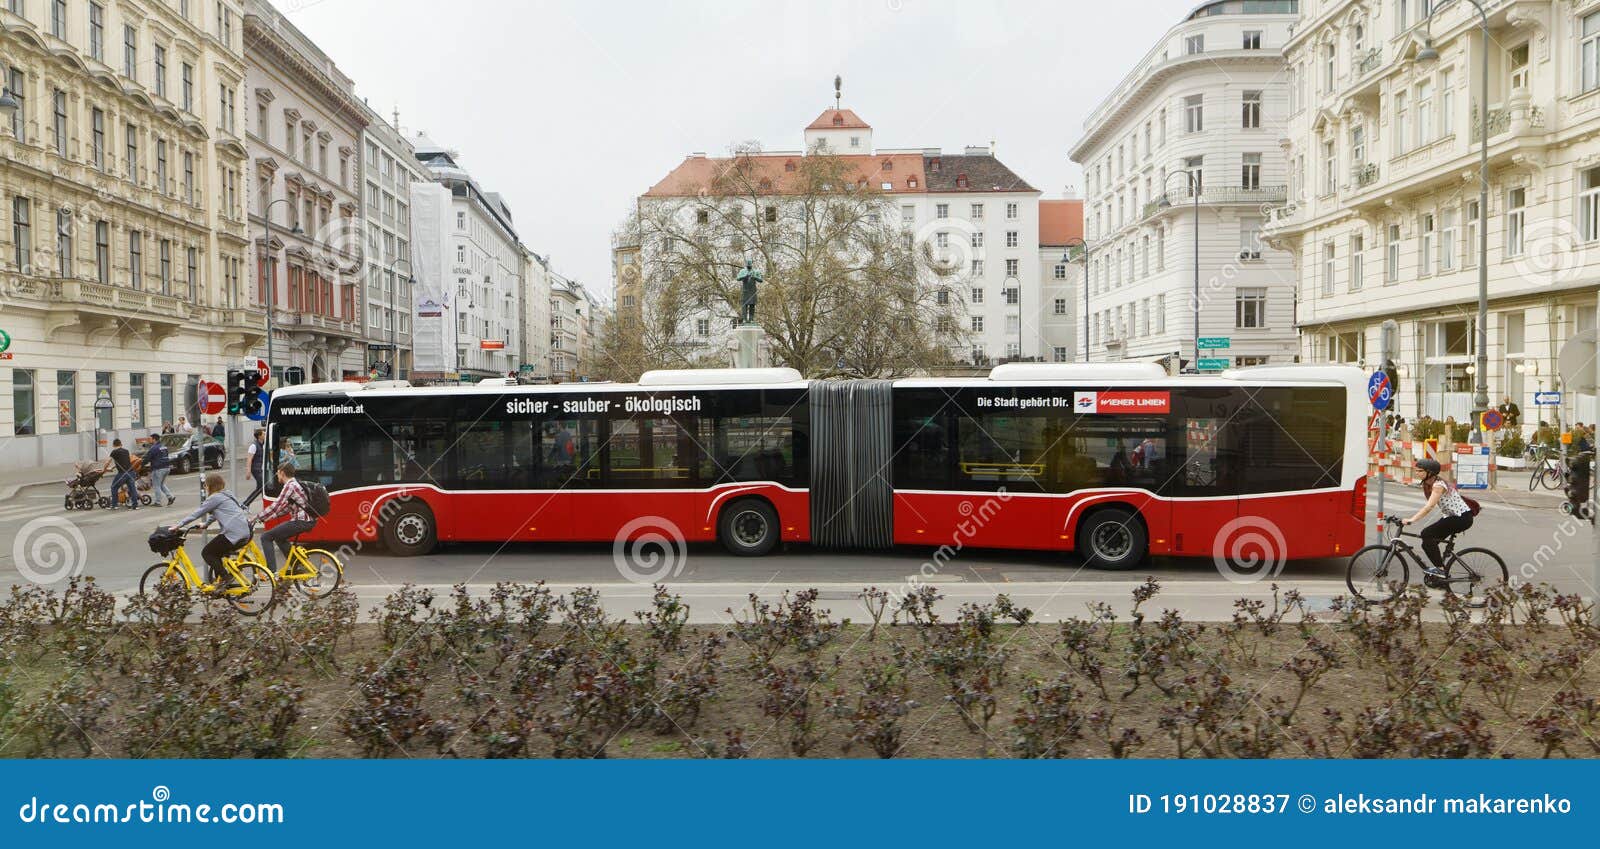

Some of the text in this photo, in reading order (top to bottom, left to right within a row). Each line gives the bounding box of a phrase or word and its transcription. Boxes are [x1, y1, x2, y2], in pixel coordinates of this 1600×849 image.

[506, 398, 549, 414] sicher
[563, 397, 611, 413] sauber
[625, 395, 701, 415] ökologisch
[977, 397, 1069, 409] Die Stadt gehört Dir.
[280, 404, 365, 415] www.wienerlinien.at
